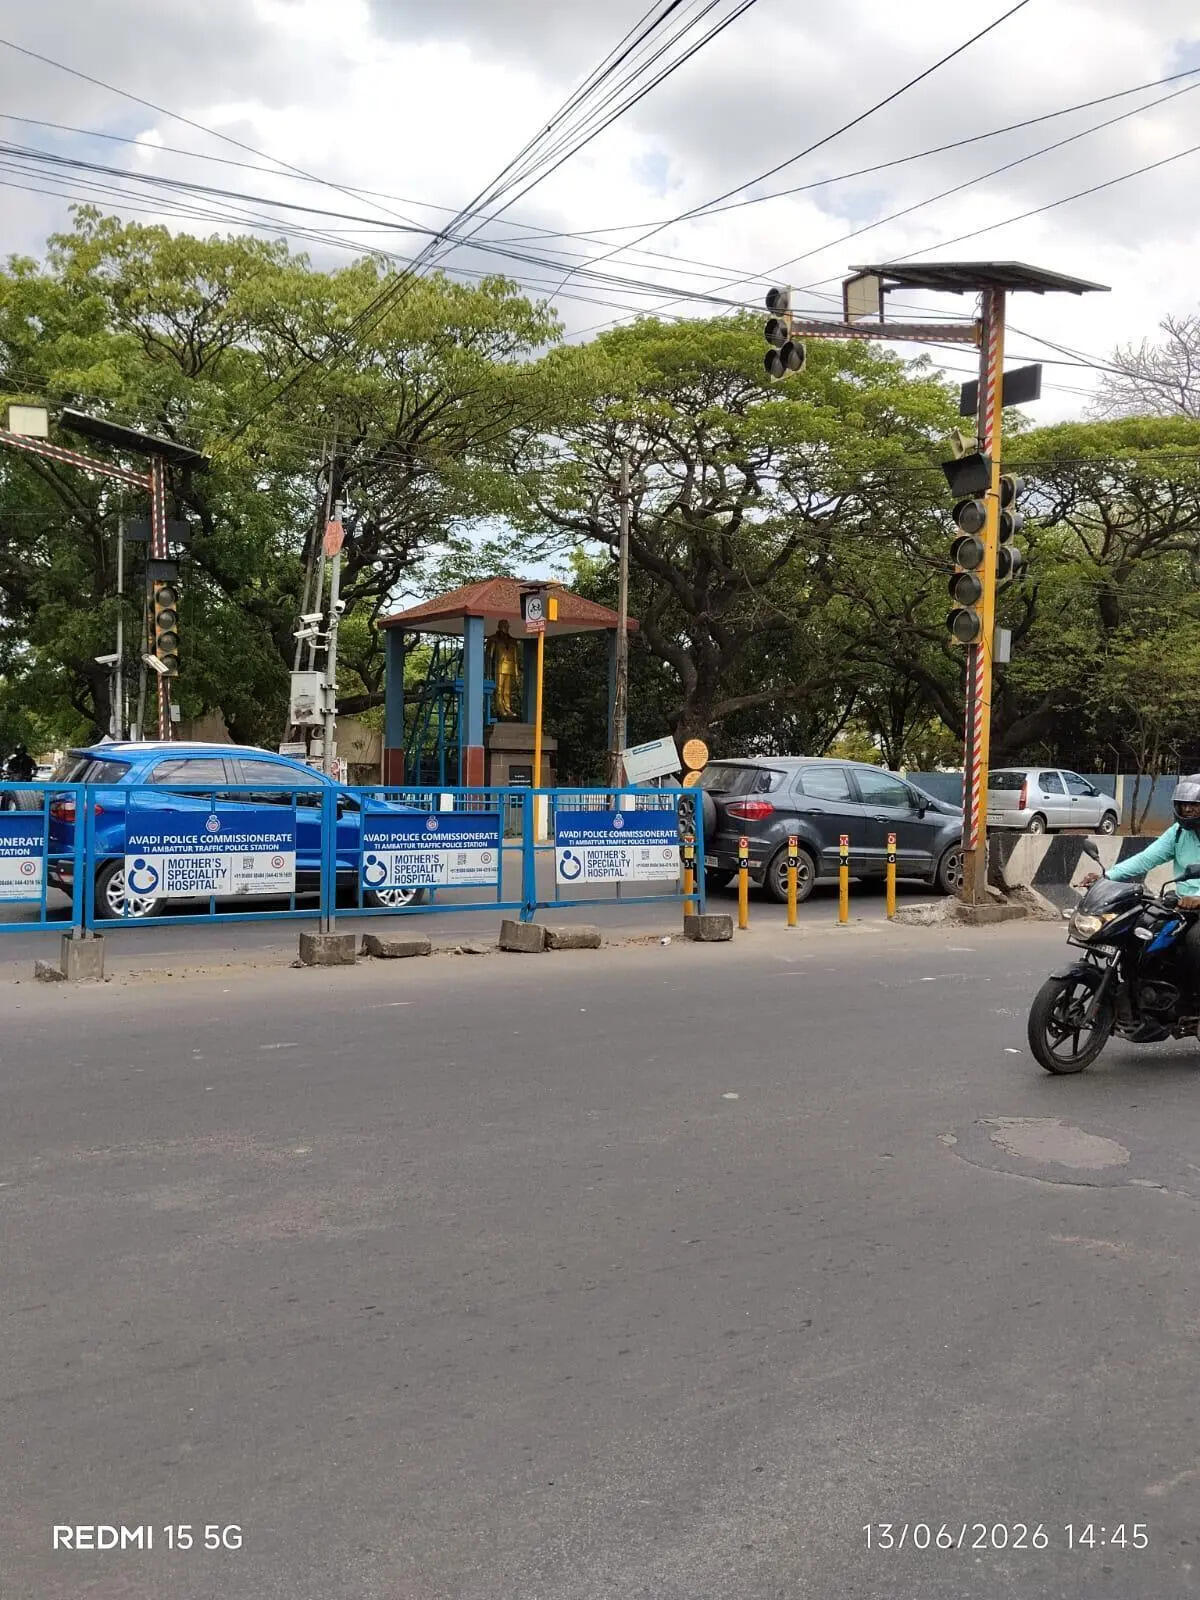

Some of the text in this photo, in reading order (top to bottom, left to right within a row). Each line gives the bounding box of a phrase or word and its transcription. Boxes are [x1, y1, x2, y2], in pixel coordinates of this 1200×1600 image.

[128, 834, 292, 844] AVADI POLICE COMMISSIONERATE
[364, 834, 389, 842] AVADI
[421, 832, 498, 841] COMMISSIONERATE
[395, 855, 439, 864] MOTHER'S
[587, 850, 626, 859] MOTHER'S
[168, 858, 221, 869] MOTHER'S
[587, 859, 630, 868] SPECIALITY
[394, 864, 444, 874] SPECIALITY
[587, 869, 624, 877] HOSPITAL
[168, 869, 226, 880] SPECIALITY
[394, 874, 436, 884] HOSPITAL
[168, 879, 217, 891] HOSPITAL
